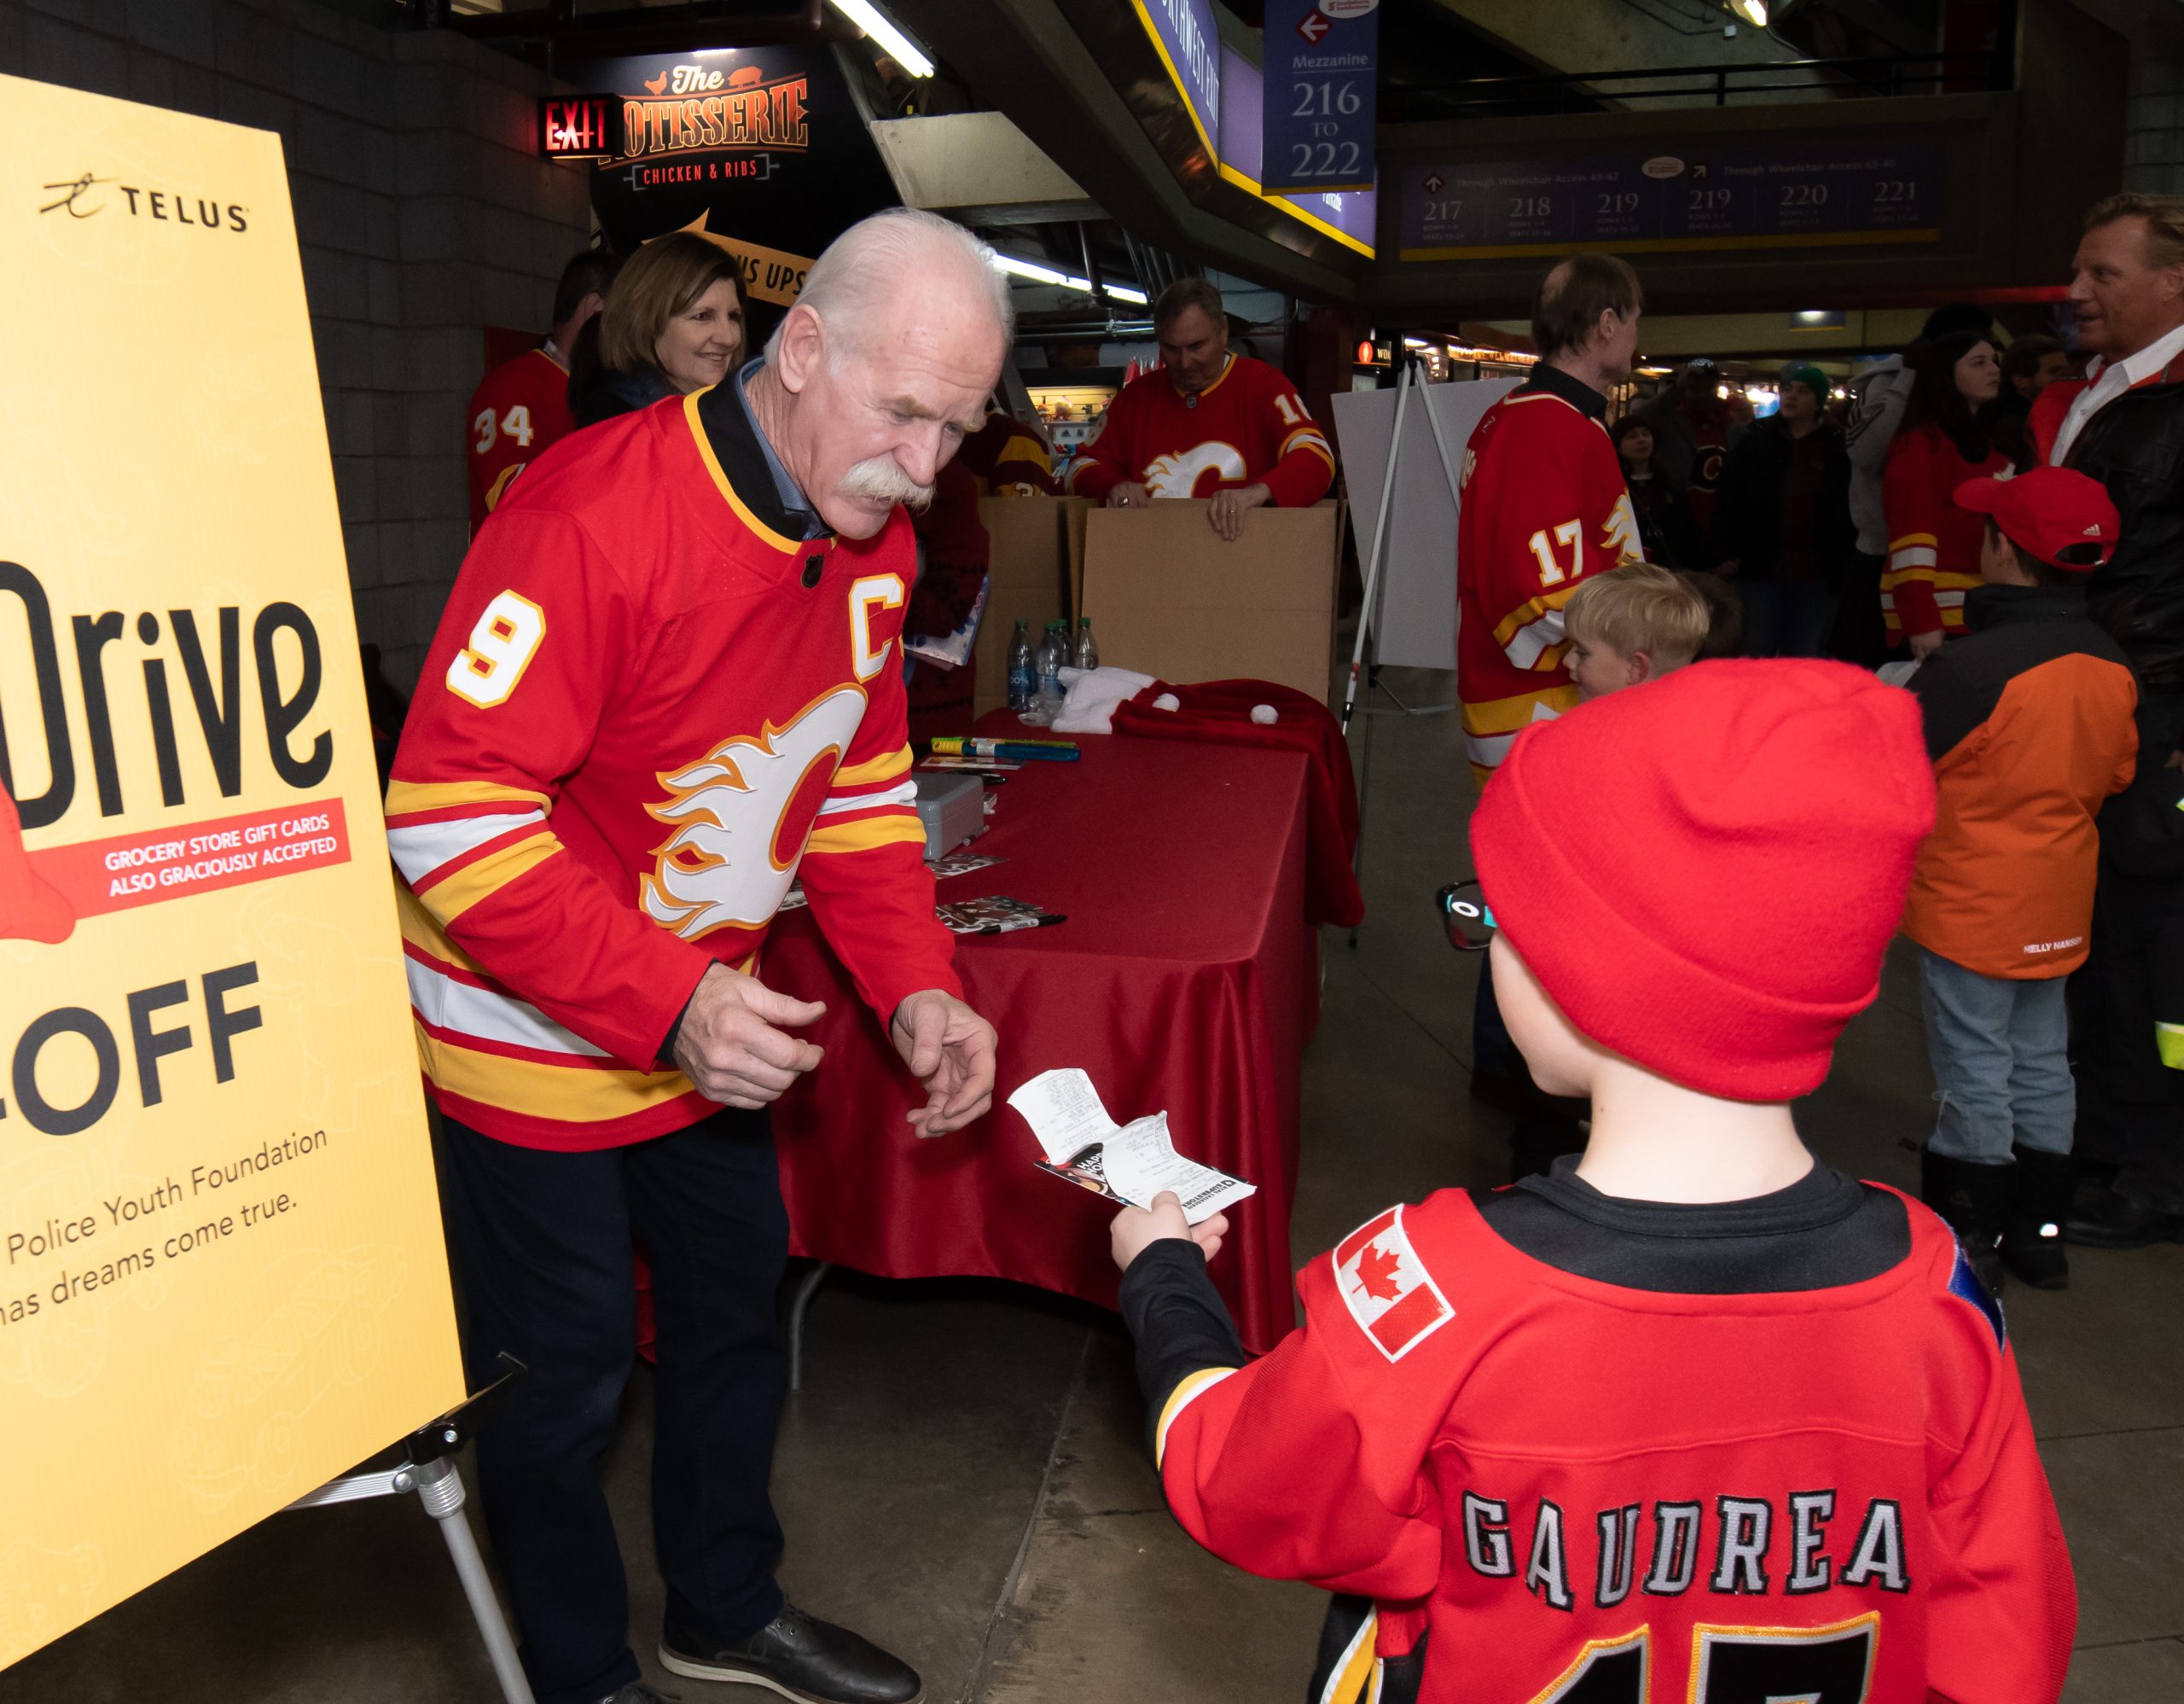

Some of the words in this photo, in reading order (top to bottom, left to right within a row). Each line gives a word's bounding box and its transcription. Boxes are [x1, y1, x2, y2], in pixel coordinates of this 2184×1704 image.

[672, 65, 724, 95] The
[1292, 54, 1368, 69] Mezzanine
[599, 79, 809, 165] OTISSERIE
[1292, 81, 1361, 117] 216
[546, 101, 606, 150] EXIT
[1311, 122, 1339, 137] TO
[643, 164, 702, 185] CHICKEN
[710, 163, 717, 179] &
[725, 160, 758, 178] RIBS
[1291, 142, 1362, 177] 222
[120, 185, 247, 232] TELUS
[1424, 201, 1462, 221] 217
[1509, 197, 1551, 217] 218
[1598, 193, 1639, 213] 219
[1689, 189, 1731, 210] 219
[1780, 184, 1827, 206] 220
[1874, 181, 1916, 202] 221
[474, 405, 533, 454] 34
[1529, 518, 1583, 587] 17
[445, 589, 546, 709] 9
[848, 573, 904, 683] C
[0, 561, 334, 830] Drive
[105, 840, 186, 870] GROCERY
[189, 830, 241, 855] STORE
[244, 823, 277, 845] GIFT
[281, 814, 329, 838] CARDS
[109, 872, 156, 897] ALSO
[160, 852, 258, 887] GRACIOUSLY
[262, 836, 337, 866] ACCEPTED
[2024, 942, 2052, 954] HELLY
[0, 961, 263, 1136] OFF
[8, 1216, 96, 1265] Police
[104, 1177, 183, 1225] Youth
[191, 1130, 328, 1195] Foundation
[51, 1247, 154, 1304] dreams
[165, 1216, 233, 1258] come
[241, 1194, 297, 1227] true.
[1461, 1488, 1912, 1613] GAUDREA
